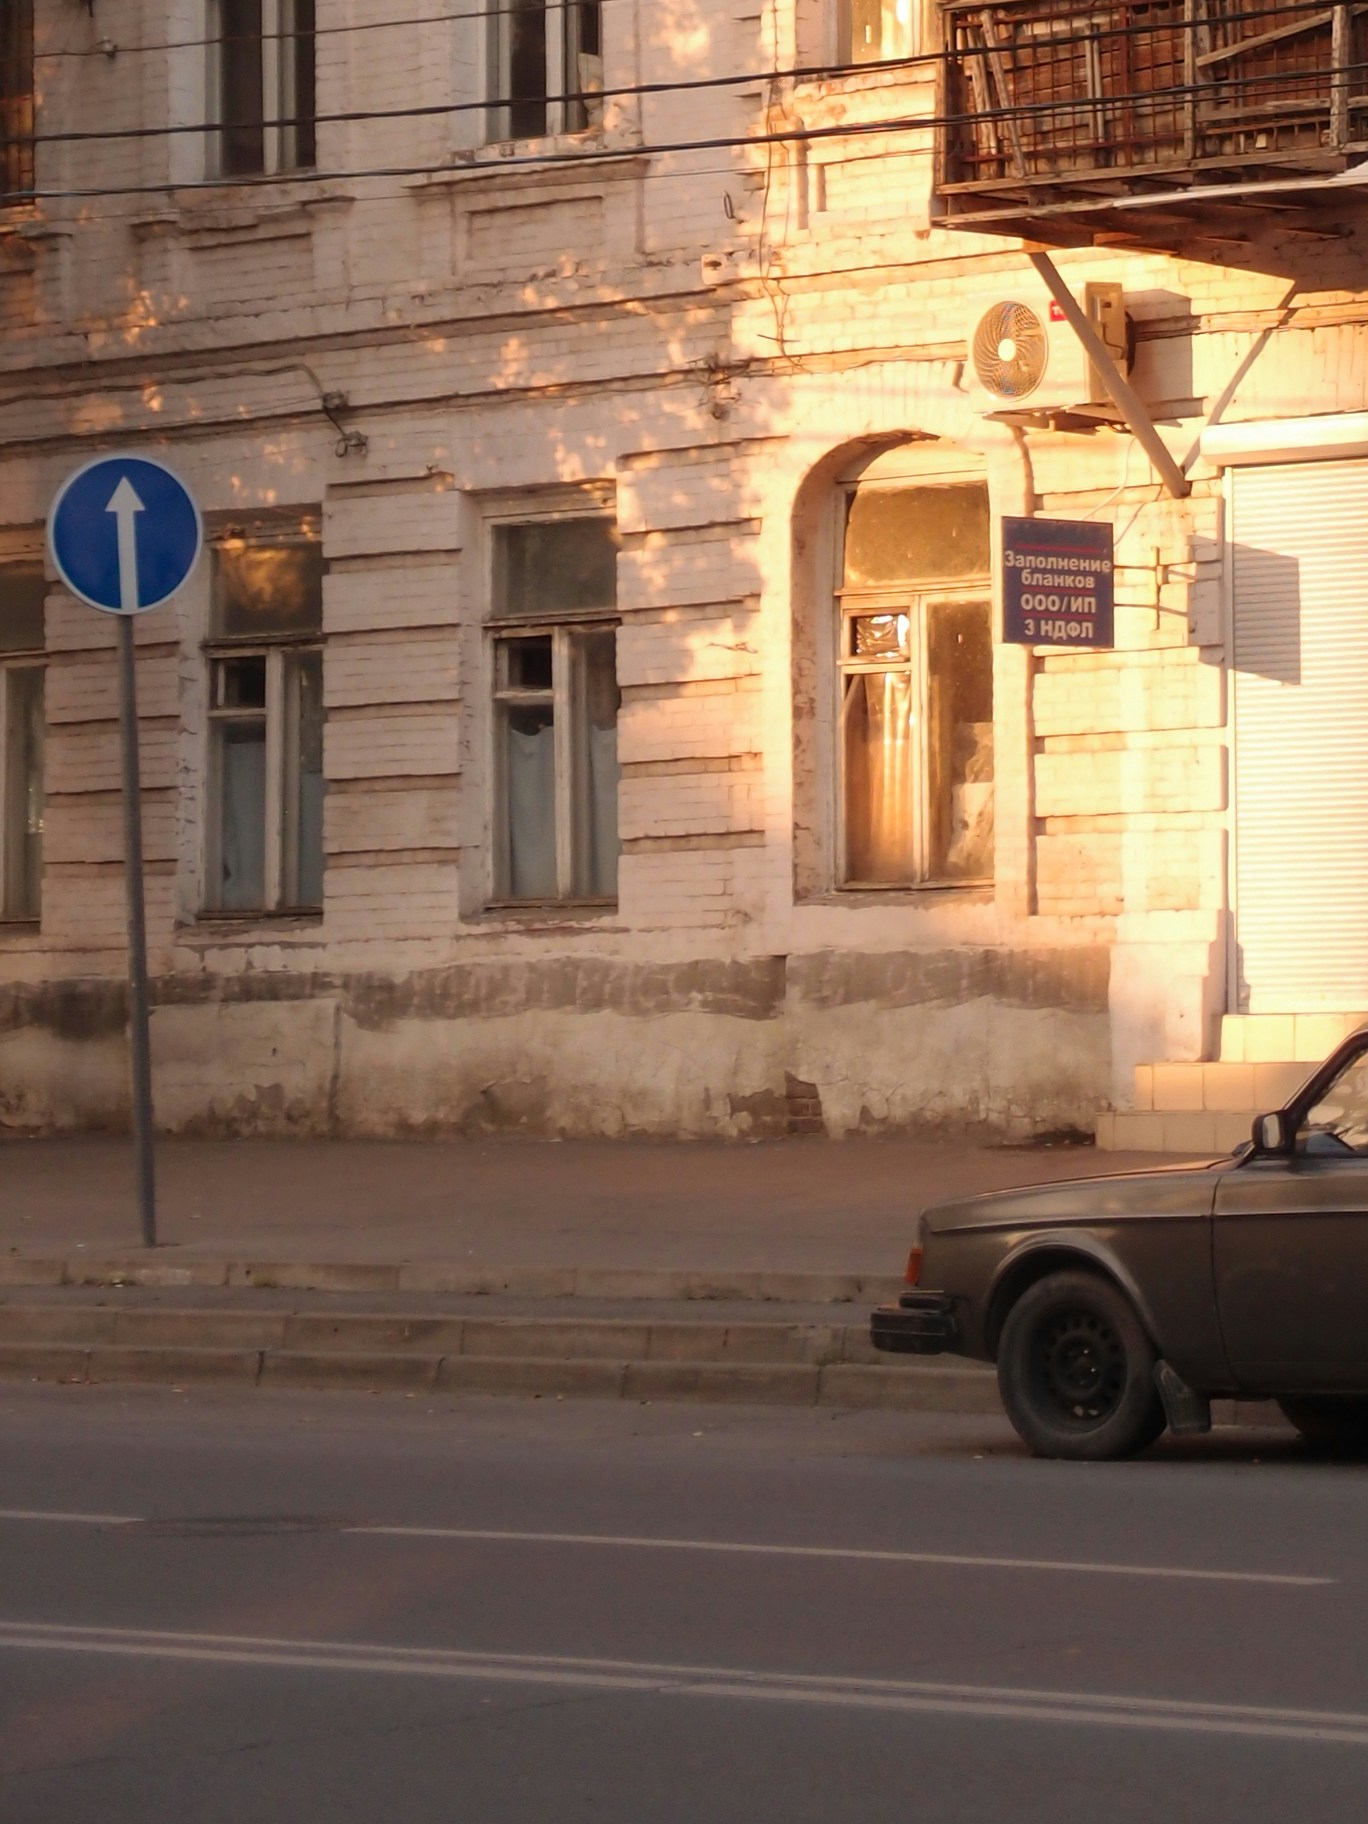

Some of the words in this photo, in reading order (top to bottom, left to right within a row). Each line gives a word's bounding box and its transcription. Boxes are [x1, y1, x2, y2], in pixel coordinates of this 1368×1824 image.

[1004, 550, 1112, 573] Заполнение
[1021, 569, 1095, 588] бланков
[1020, 594, 1096, 613] ООО/ИП
[1040, 620, 1094, 640] НДФЛ
